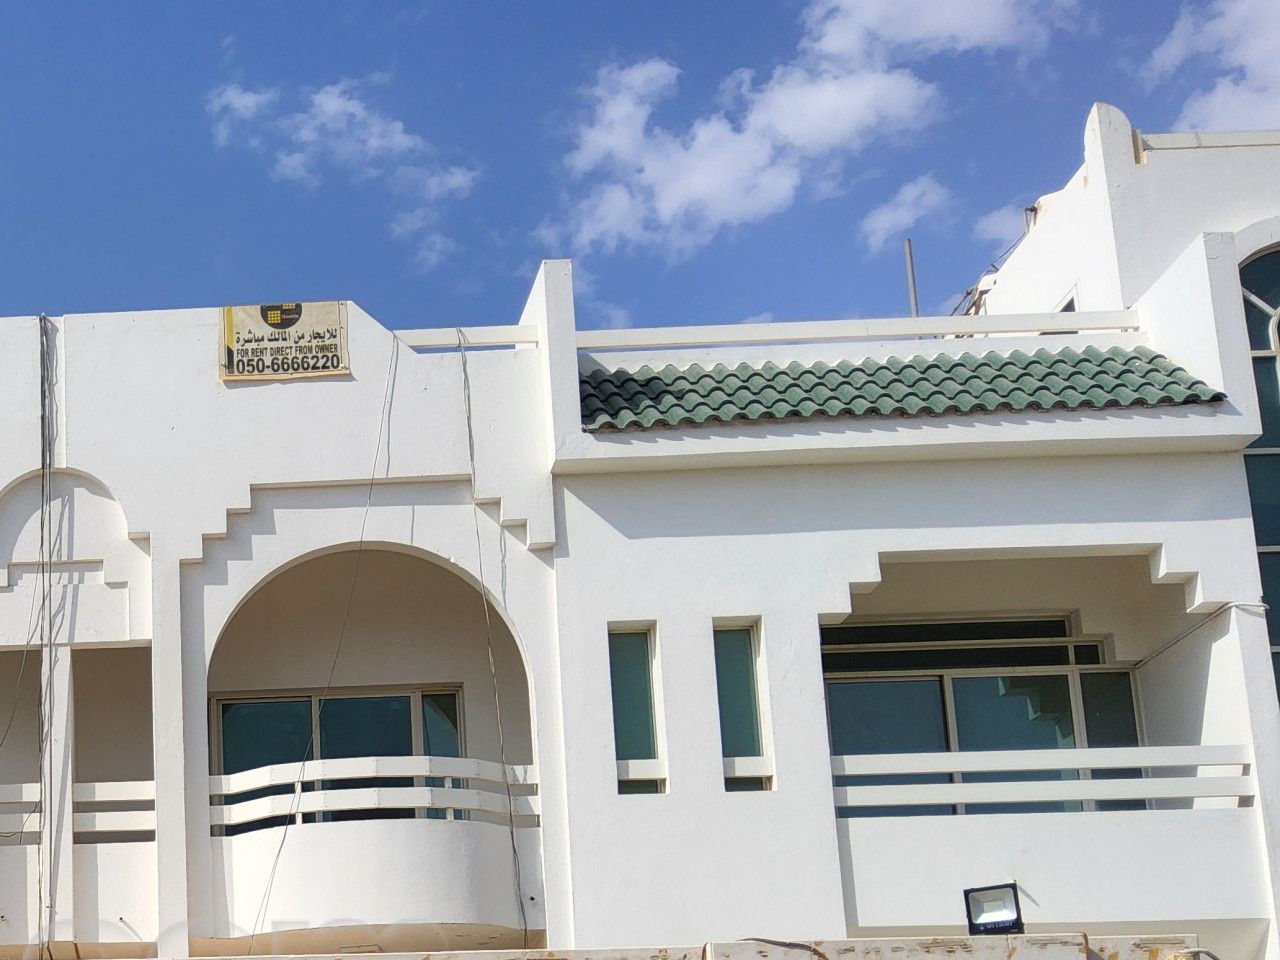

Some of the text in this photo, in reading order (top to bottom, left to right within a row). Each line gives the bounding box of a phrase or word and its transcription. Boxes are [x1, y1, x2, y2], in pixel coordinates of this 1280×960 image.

[235, 329, 265, 347] مباشرة
[267, 330, 291, 342] المالك
[294, 331, 305, 344] من
[236, 343, 339, 358] FOR RENT DIRECT FROM OWNER
[236, 354, 340, 374] 050-6666220
